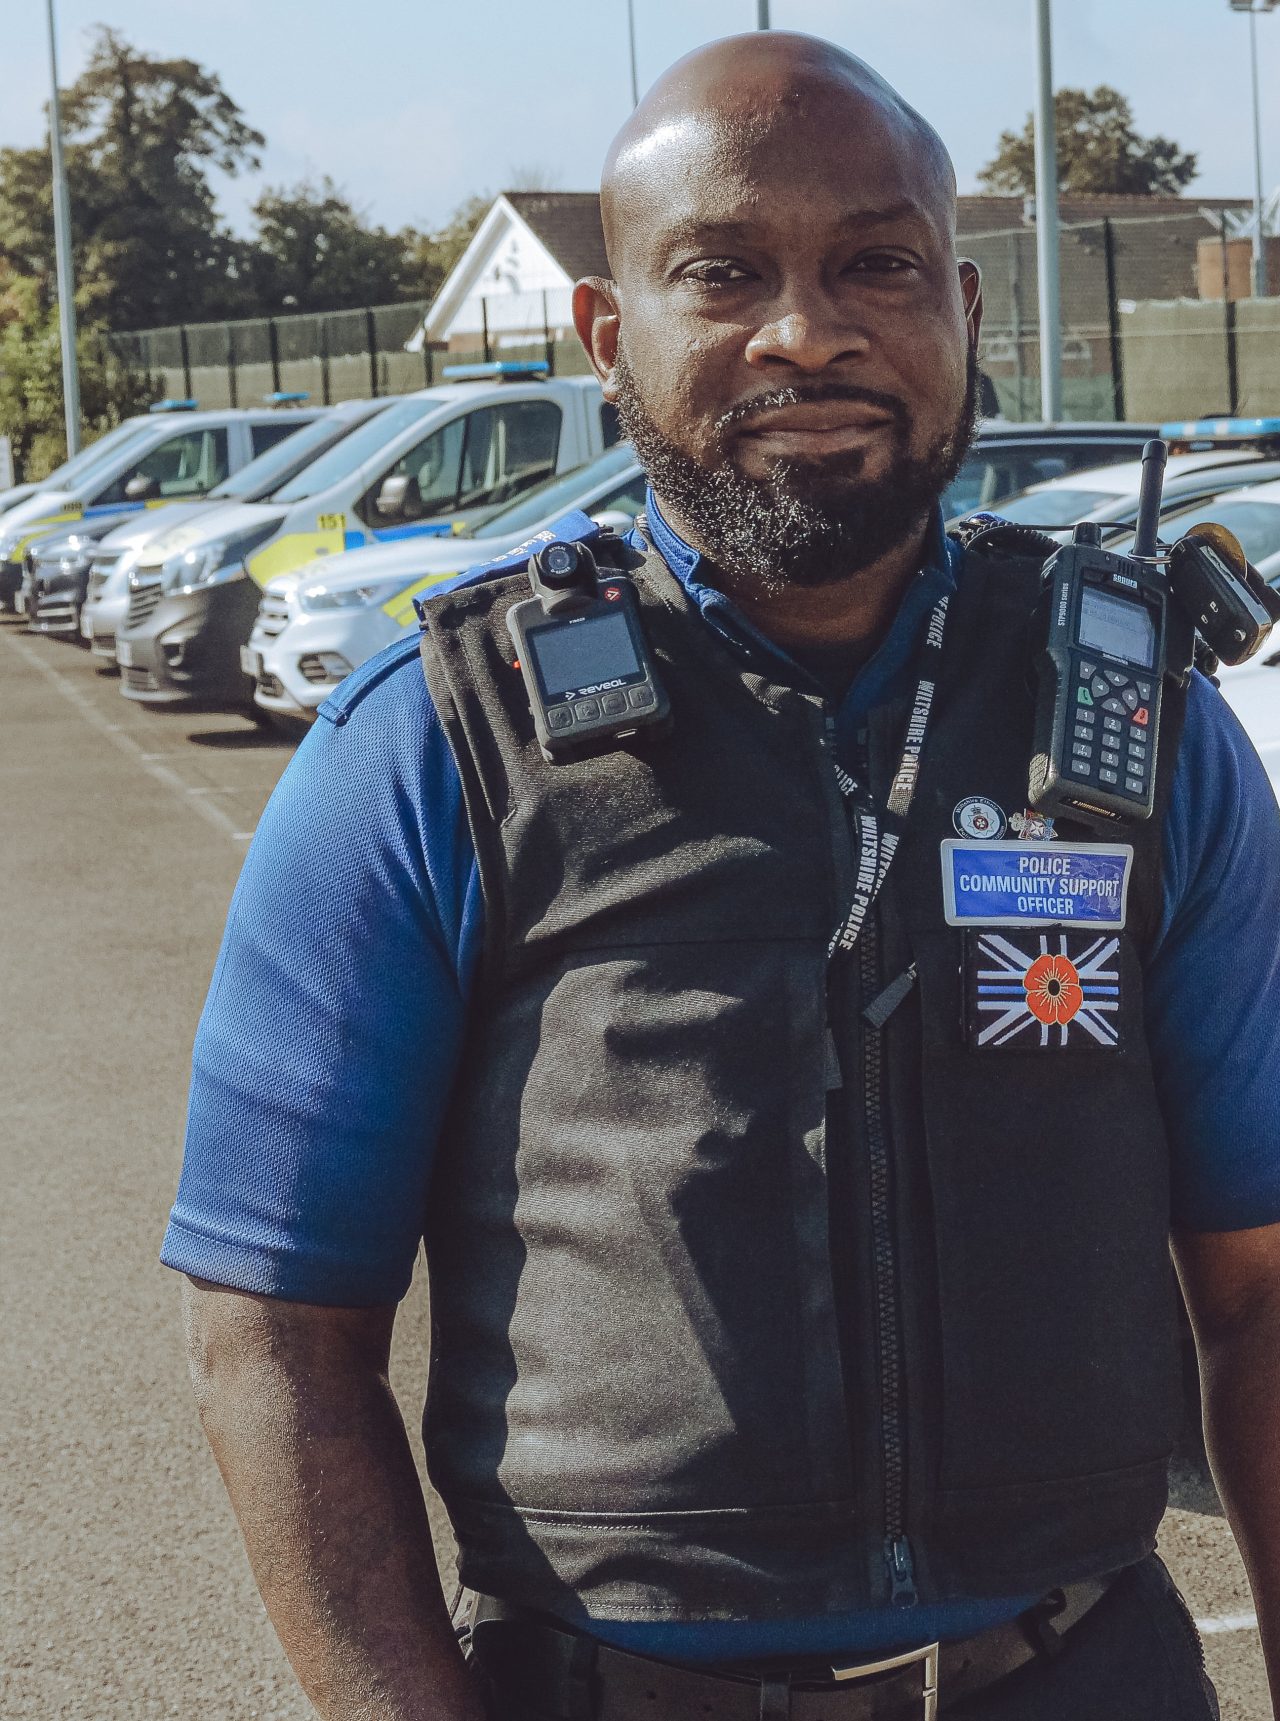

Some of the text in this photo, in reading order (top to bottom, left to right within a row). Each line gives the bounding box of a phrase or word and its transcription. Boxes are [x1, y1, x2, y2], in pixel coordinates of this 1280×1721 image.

[926, 606, 946, 649] POLICE
[895, 679, 936, 791] WILTSHIRE POLICE
[1019, 856, 1071, 875] POLICE
[838, 815, 878, 950] WILTSHIRE POLICE
[959, 874, 1120, 898] COMMUNITY SUPPORT
[1017, 896, 1074, 915] OFFICER
